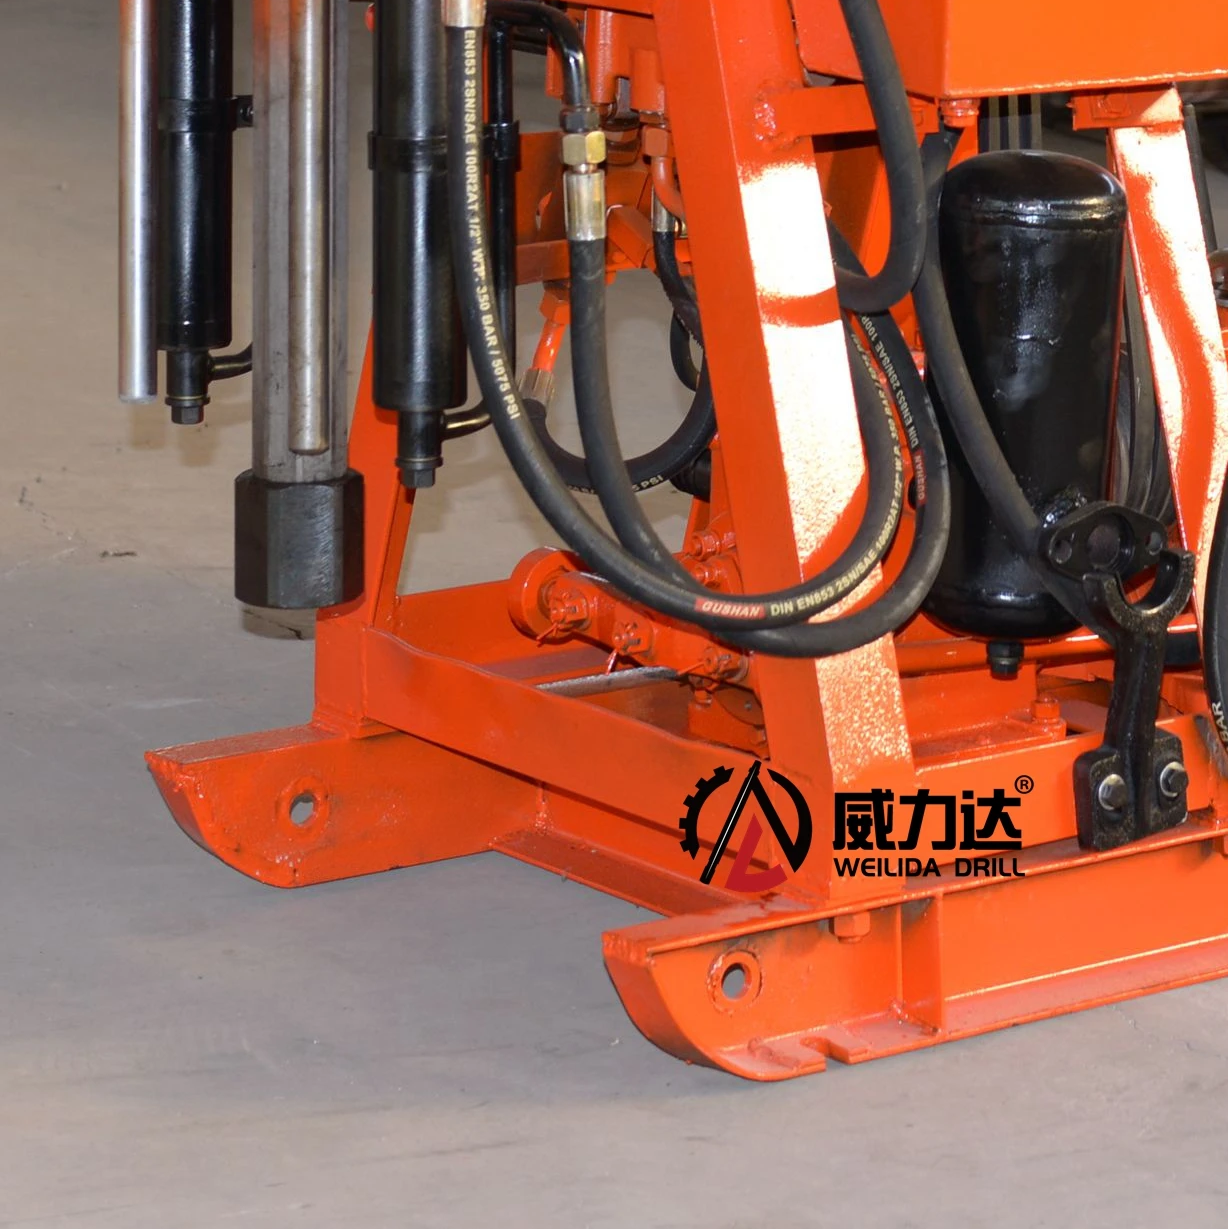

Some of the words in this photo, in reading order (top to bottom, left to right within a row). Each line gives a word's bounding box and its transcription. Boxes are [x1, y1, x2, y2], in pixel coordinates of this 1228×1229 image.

[464, 29, 476, 75] EN853
[464, 79, 478, 144] 2SN/SAE
[465, 149, 479, 211] 100R2AT
[476, 285, 491, 311] 350
[482, 314, 498, 348] BAR
[491, 358, 511, 392] 5075
[875, 341, 900, 390] 2SN/SAE
[503, 393, 520, 420] PSI
[896, 389, 913, 427] EN853
[908, 425, 919, 448] DIN
[770, 601, 793, 616] DIN
[797, 586, 836, 611] EN853
